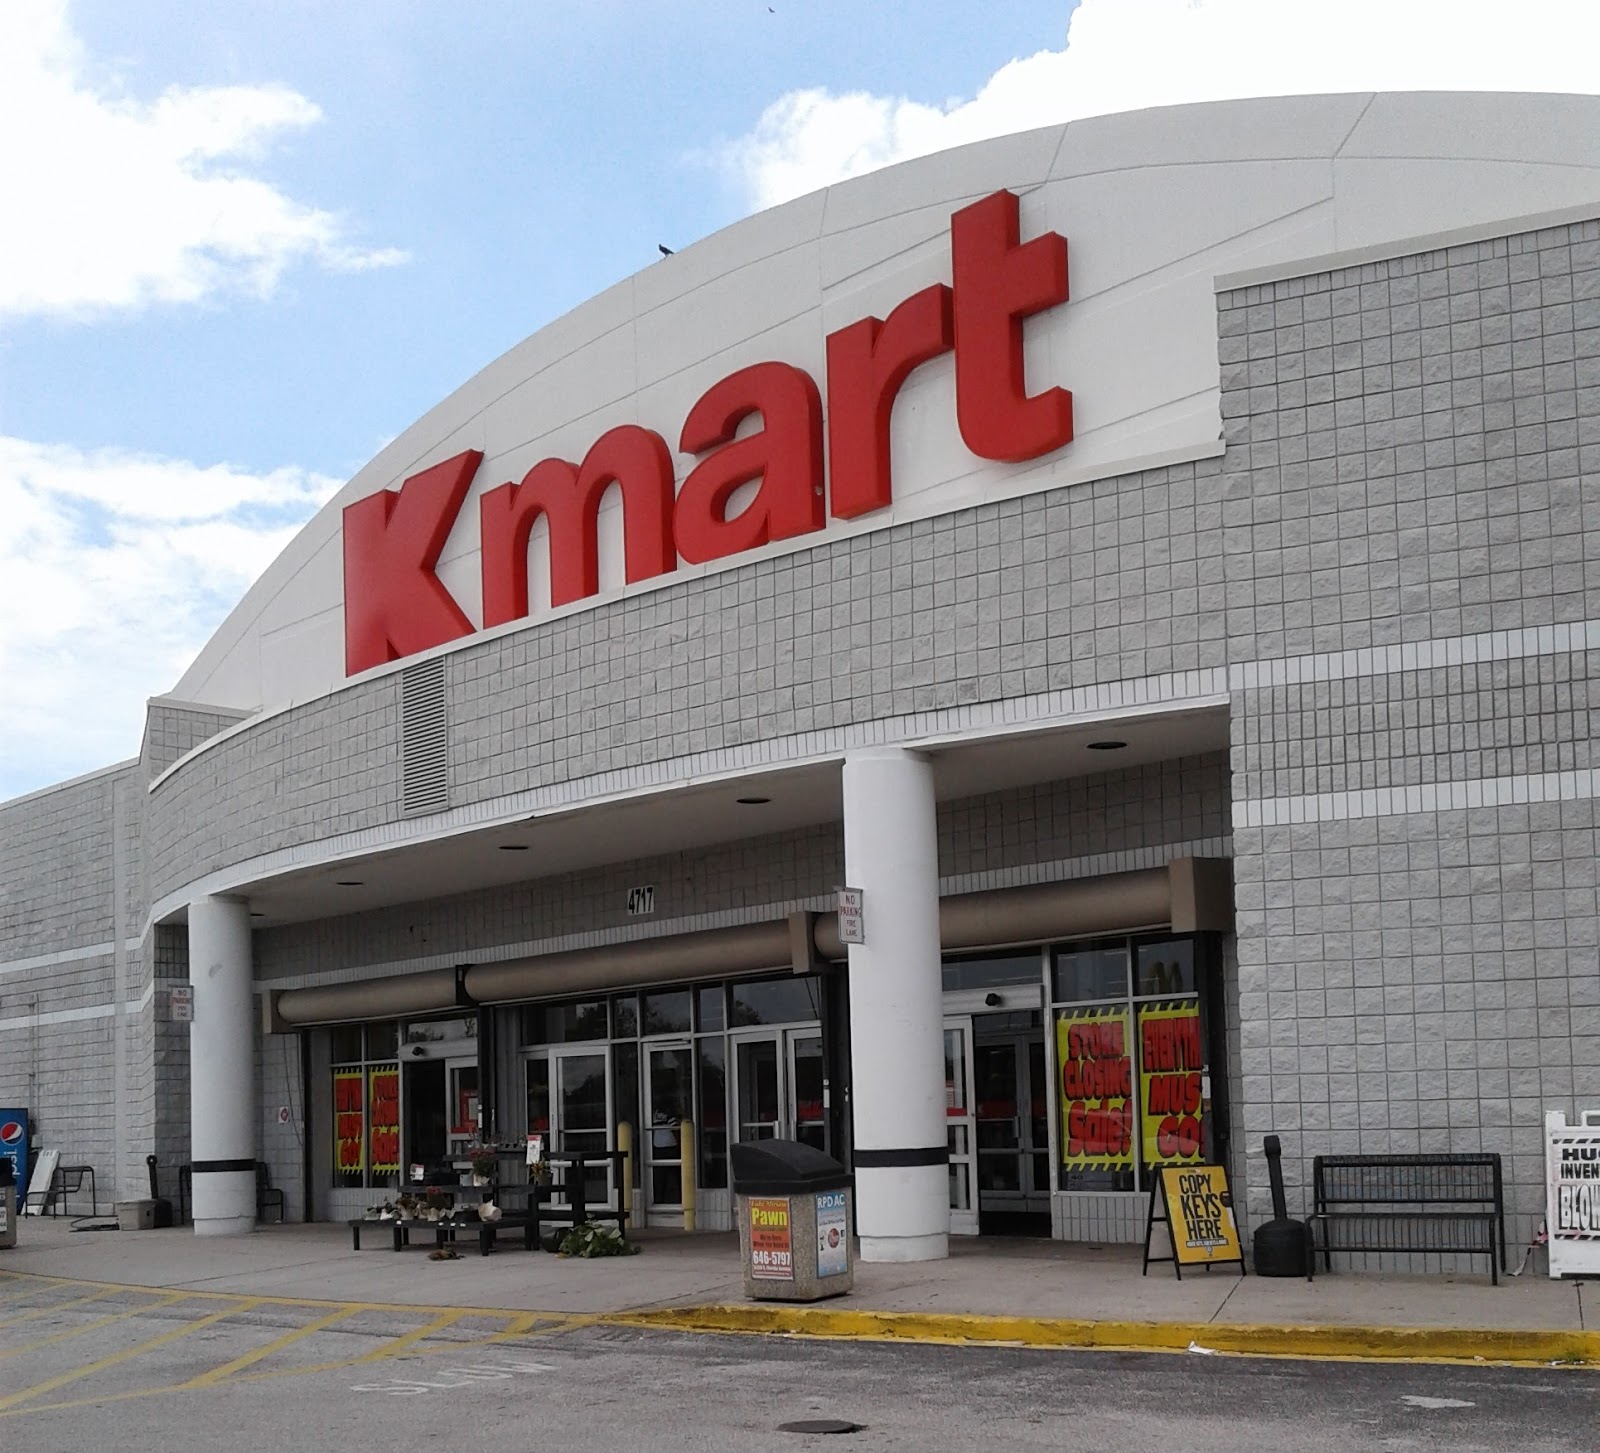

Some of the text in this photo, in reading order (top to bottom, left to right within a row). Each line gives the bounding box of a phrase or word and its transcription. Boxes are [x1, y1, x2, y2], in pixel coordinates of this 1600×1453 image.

[343, 188, 1074, 677] Kmart
[629, 887, 653, 914] 4717
[846, 894, 855, 904] NO
[1069, 1022, 1124, 1059] STORE
[1064, 1057, 1131, 1100] CLOSING
[1148, 1073, 1201, 1115] MUS
[1562, 1148, 1600, 1161] HU
[1179, 1173, 1212, 1195] COPY
[818, 1194, 845, 1208] RPD AC
[1180, 1193, 1222, 1220] KEYS
[752, 1208, 787, 1225] Pawn
[1186, 1218, 1225, 1241] HERE
[753, 1251, 790, 1265] 646-5797
